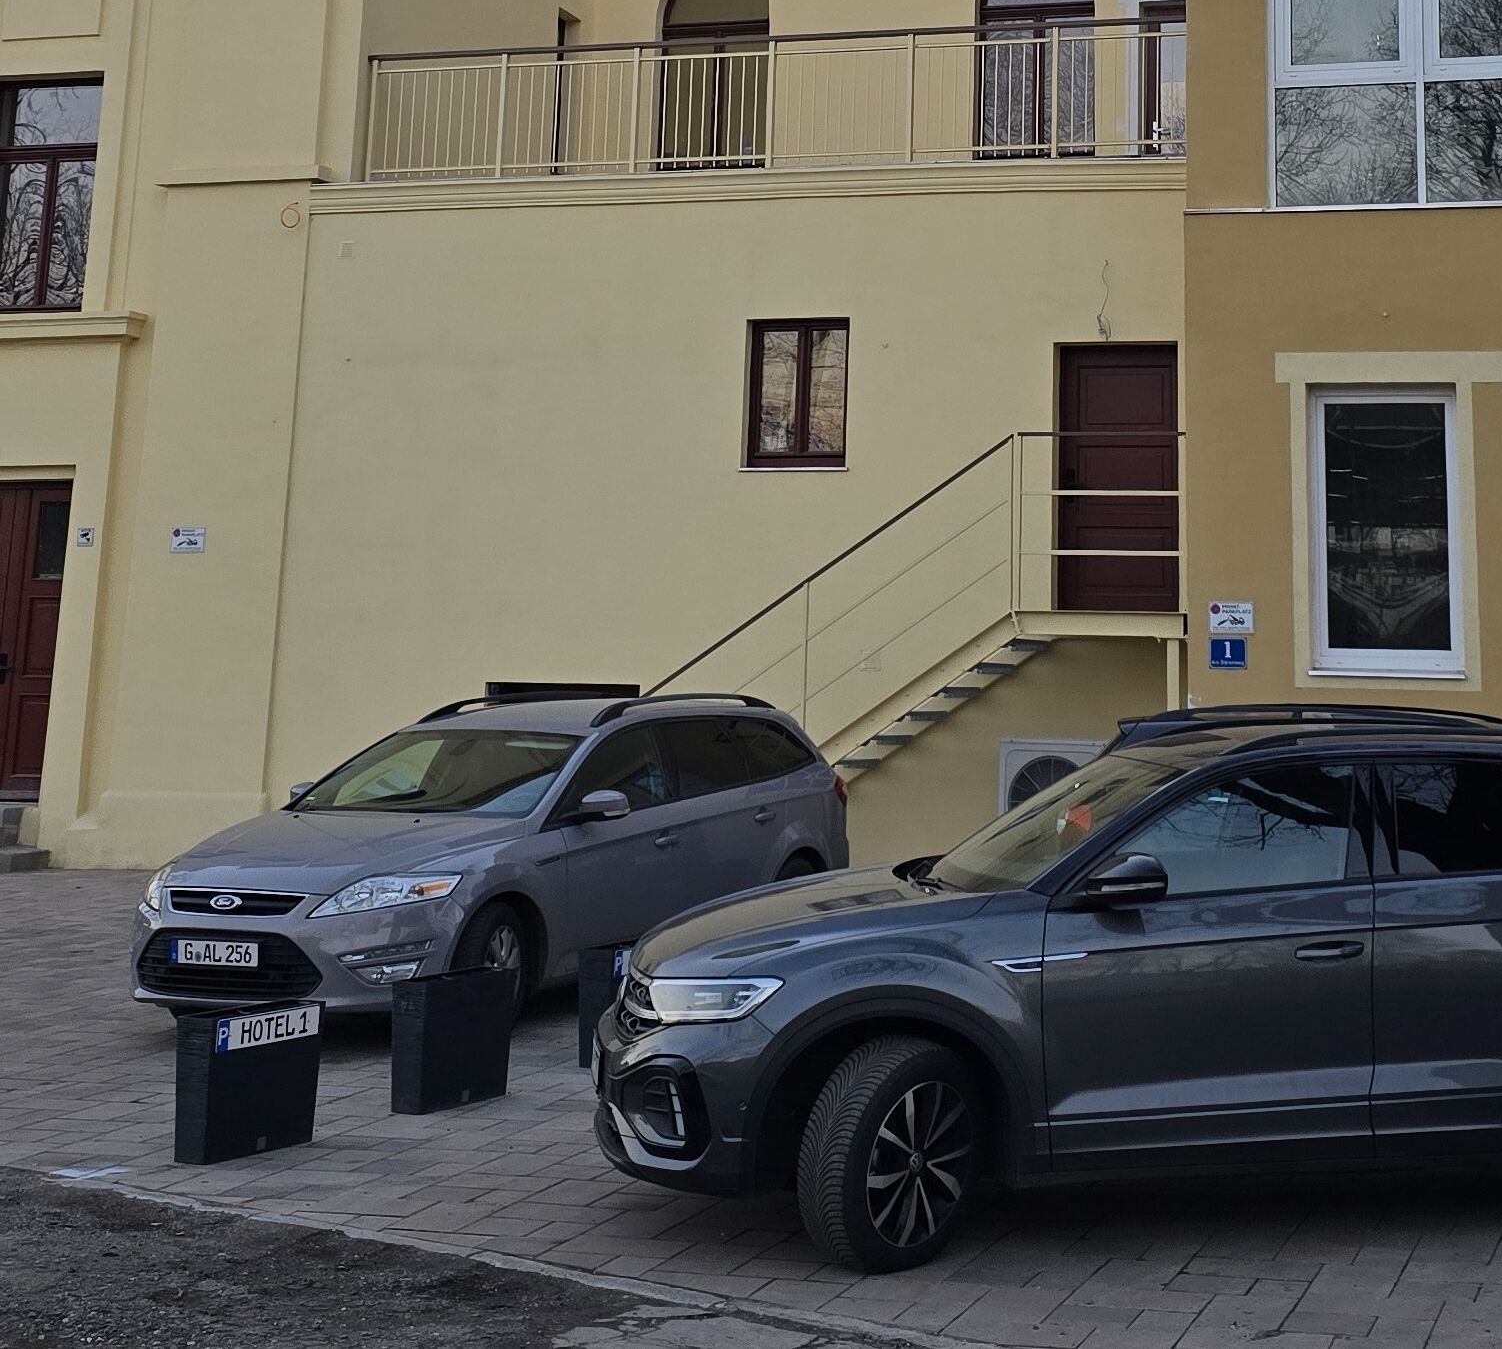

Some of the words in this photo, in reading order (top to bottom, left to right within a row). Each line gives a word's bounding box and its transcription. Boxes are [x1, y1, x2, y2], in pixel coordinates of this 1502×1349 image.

[1223, 641, 1232, 659] 1
[184, 942, 193, 961] G
[203, 944, 222, 962] AL
[225, 944, 252, 963] 256
[218, 1027, 229, 1045] P
[240, 1014, 295, 1044] HOTEL
[298, 1011, 308, 1034] 1
